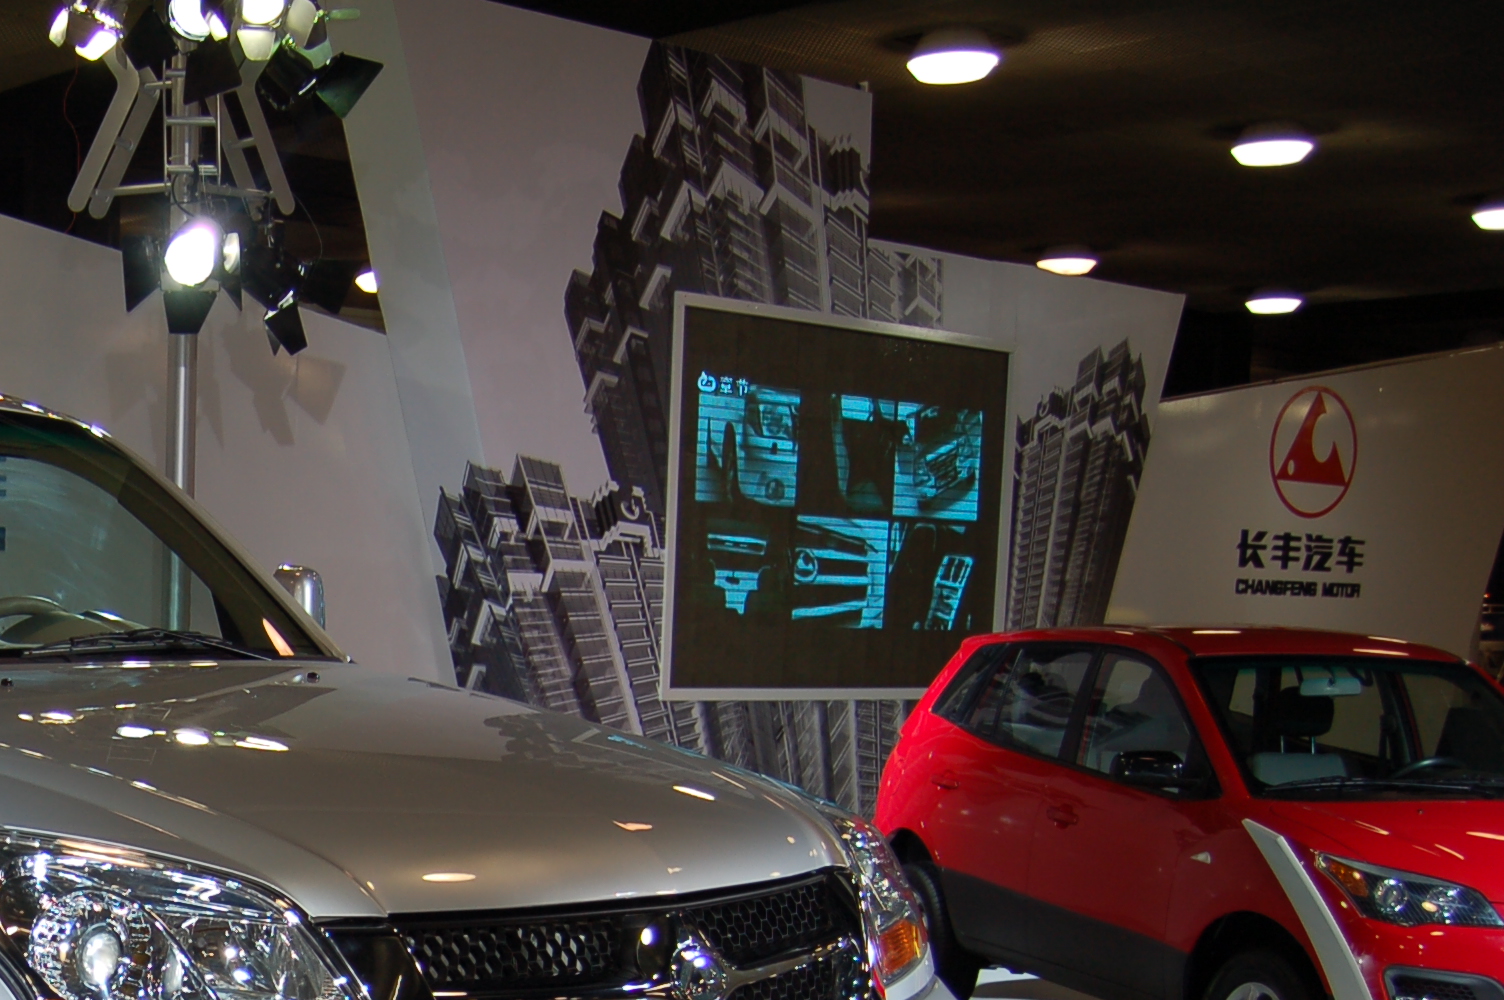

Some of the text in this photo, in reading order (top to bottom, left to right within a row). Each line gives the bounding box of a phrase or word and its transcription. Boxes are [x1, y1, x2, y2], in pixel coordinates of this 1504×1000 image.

[1236, 529, 1366, 574] 长丰汽车
[1235, 579, 1361, 598] CHANGFENG MOTOR
